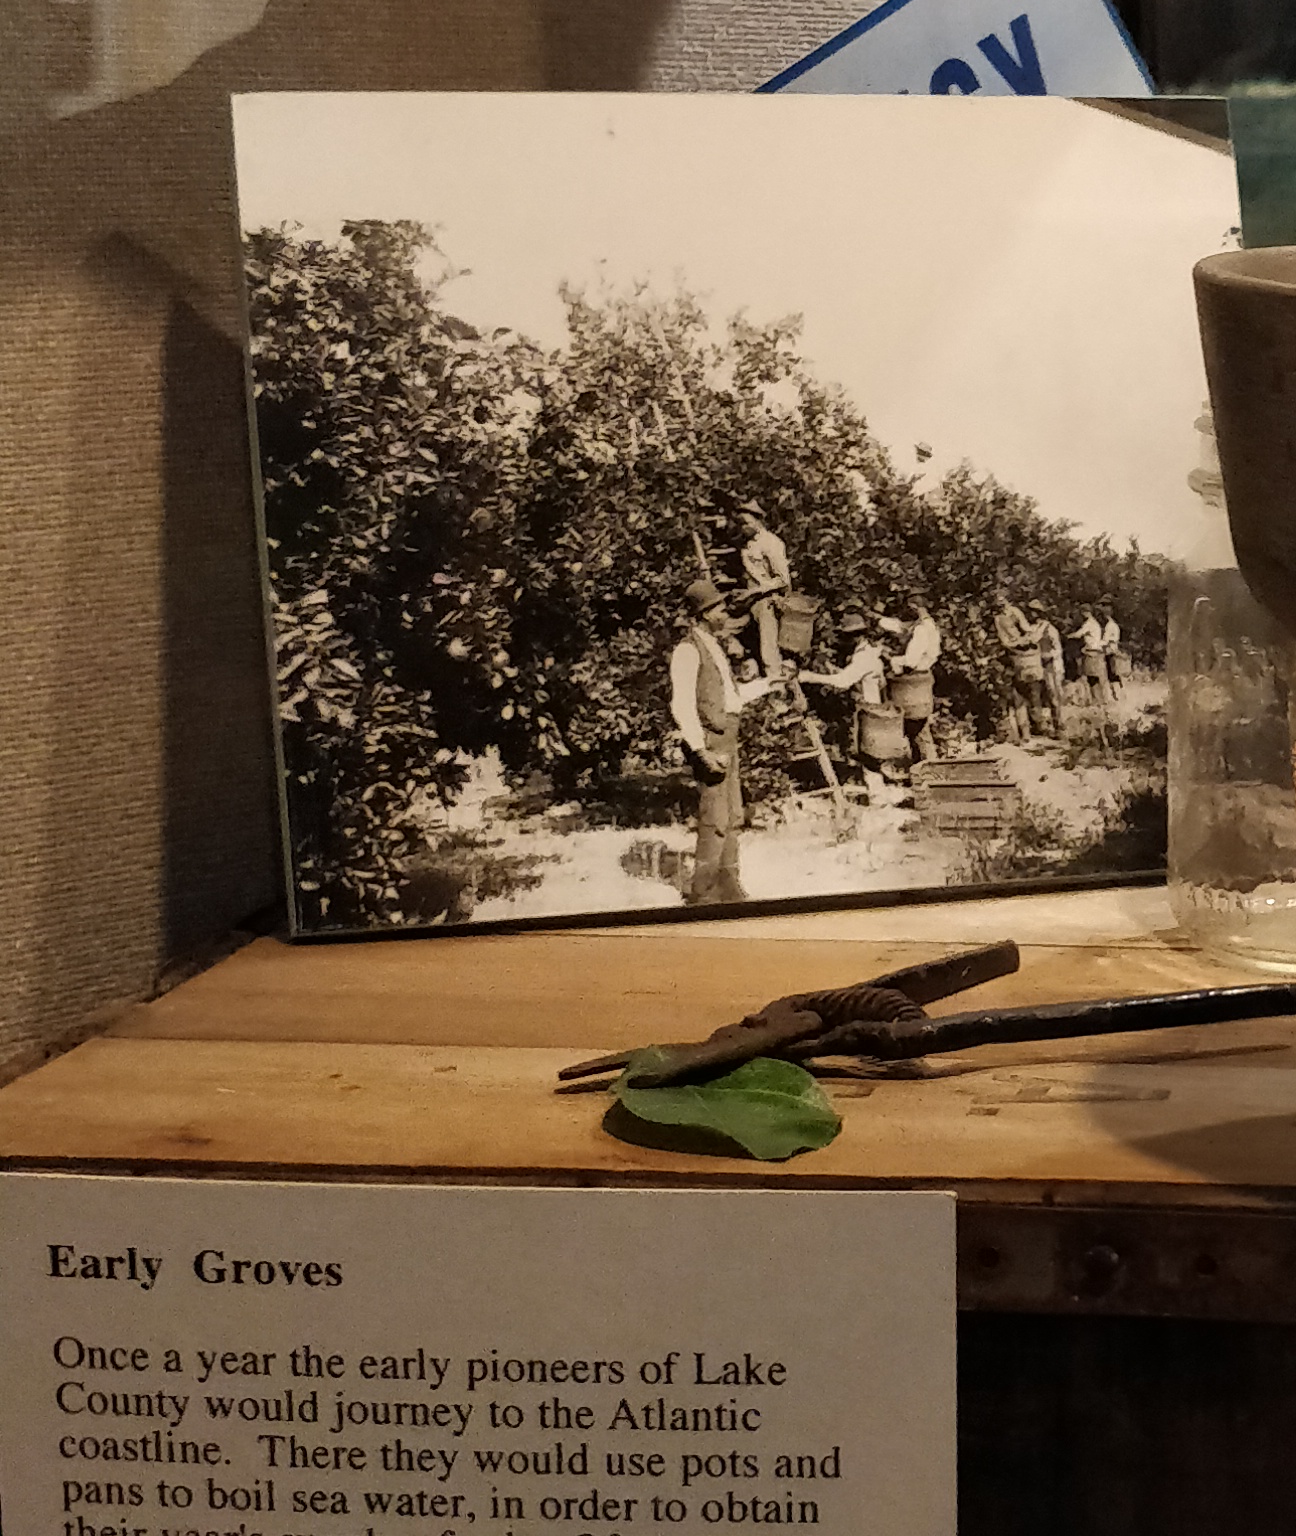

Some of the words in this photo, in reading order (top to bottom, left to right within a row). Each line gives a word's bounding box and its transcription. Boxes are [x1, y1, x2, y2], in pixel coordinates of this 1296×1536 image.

[45, 1244, 164, 1292] Early
[191, 1249, 345, 1289] Groves
[51, 1337, 151, 1373] Once
[162, 1347, 184, 1374] a
[195, 1349, 278, 1385] year
[288, 1343, 347, 1380] the
[357, 1346, 452, 1392] early
[465, 1348, 626, 1393] pioneers
[637, 1350, 682, 1386] of
[692, 1351, 788, 1388] Lake
[54, 1382, 191, 1429] County
[203, 1388, 320, 1425] would
[327, 1390, 474, 1438] journey
[487, 1400, 525, 1430] to
[536, 1395, 597, 1432] the
[606, 1396, 762, 1433] Atlantic
[61, 1479, 145, 1514] pans
[155, 1479, 194, 1510] to
[205, 1476, 277, 1513] boil
[291, 1489, 352, 1516] sea
[362, 1489, 477, 1525] water,
[488, 1485, 527, 1521] in
[538, 1487, 640, 1523] order
[649, 1494, 689, 1524] to
[699, 1489, 821, 1525] obtain
